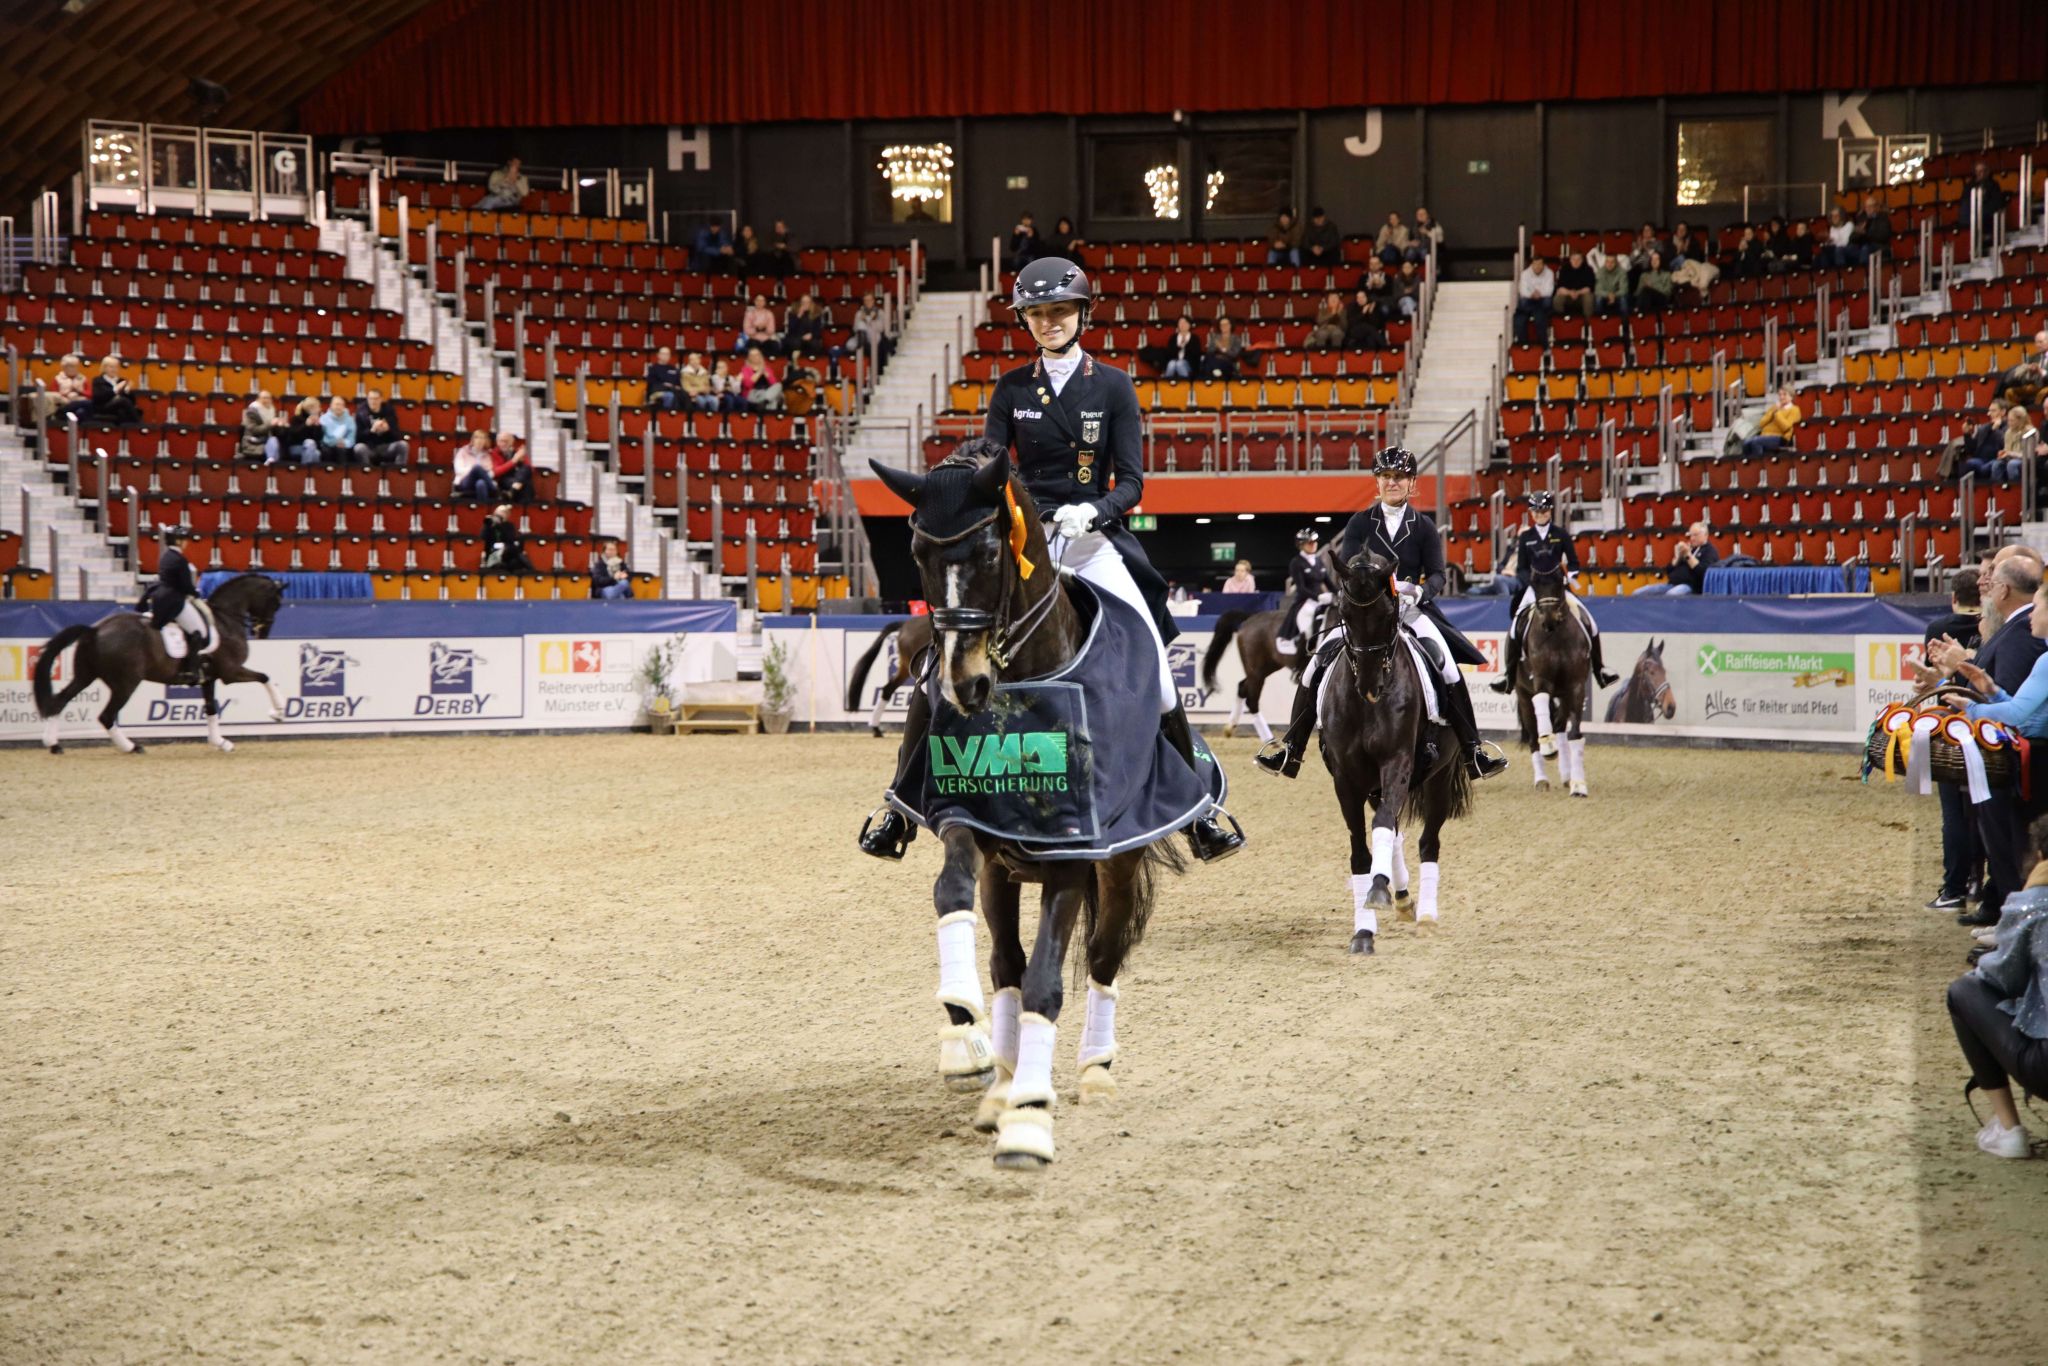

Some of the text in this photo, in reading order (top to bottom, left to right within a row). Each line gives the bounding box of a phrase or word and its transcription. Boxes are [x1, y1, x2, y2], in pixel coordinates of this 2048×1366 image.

[1822, 91, 1876, 139] K
[1343, 108, 1382, 157] J
[667, 127, 710, 171] H
[274, 150, 297, 174] G
[1848, 153, 1872, 177] K
[623, 183, 644, 206] H
[1013, 408, 1035, 420] Agria
[1725, 653, 1824, 671] Raiffeisen-Markt
[538, 680, 635, 694] Reiterverband
[285, 696, 363, 718] DERBY
[414, 693, 491, 716] DERBY
[544, 697, 628, 712] Münster e.V.
[1473, 699, 1518, 713] nster e.V
[1705, 690, 1838, 715] Alles für Reiter und Pferd
[0, 708, 91, 723] Müns e.V.
[929, 733, 1022, 777] LVM
[935, 776, 1068, 794] VERSICHERUNG
